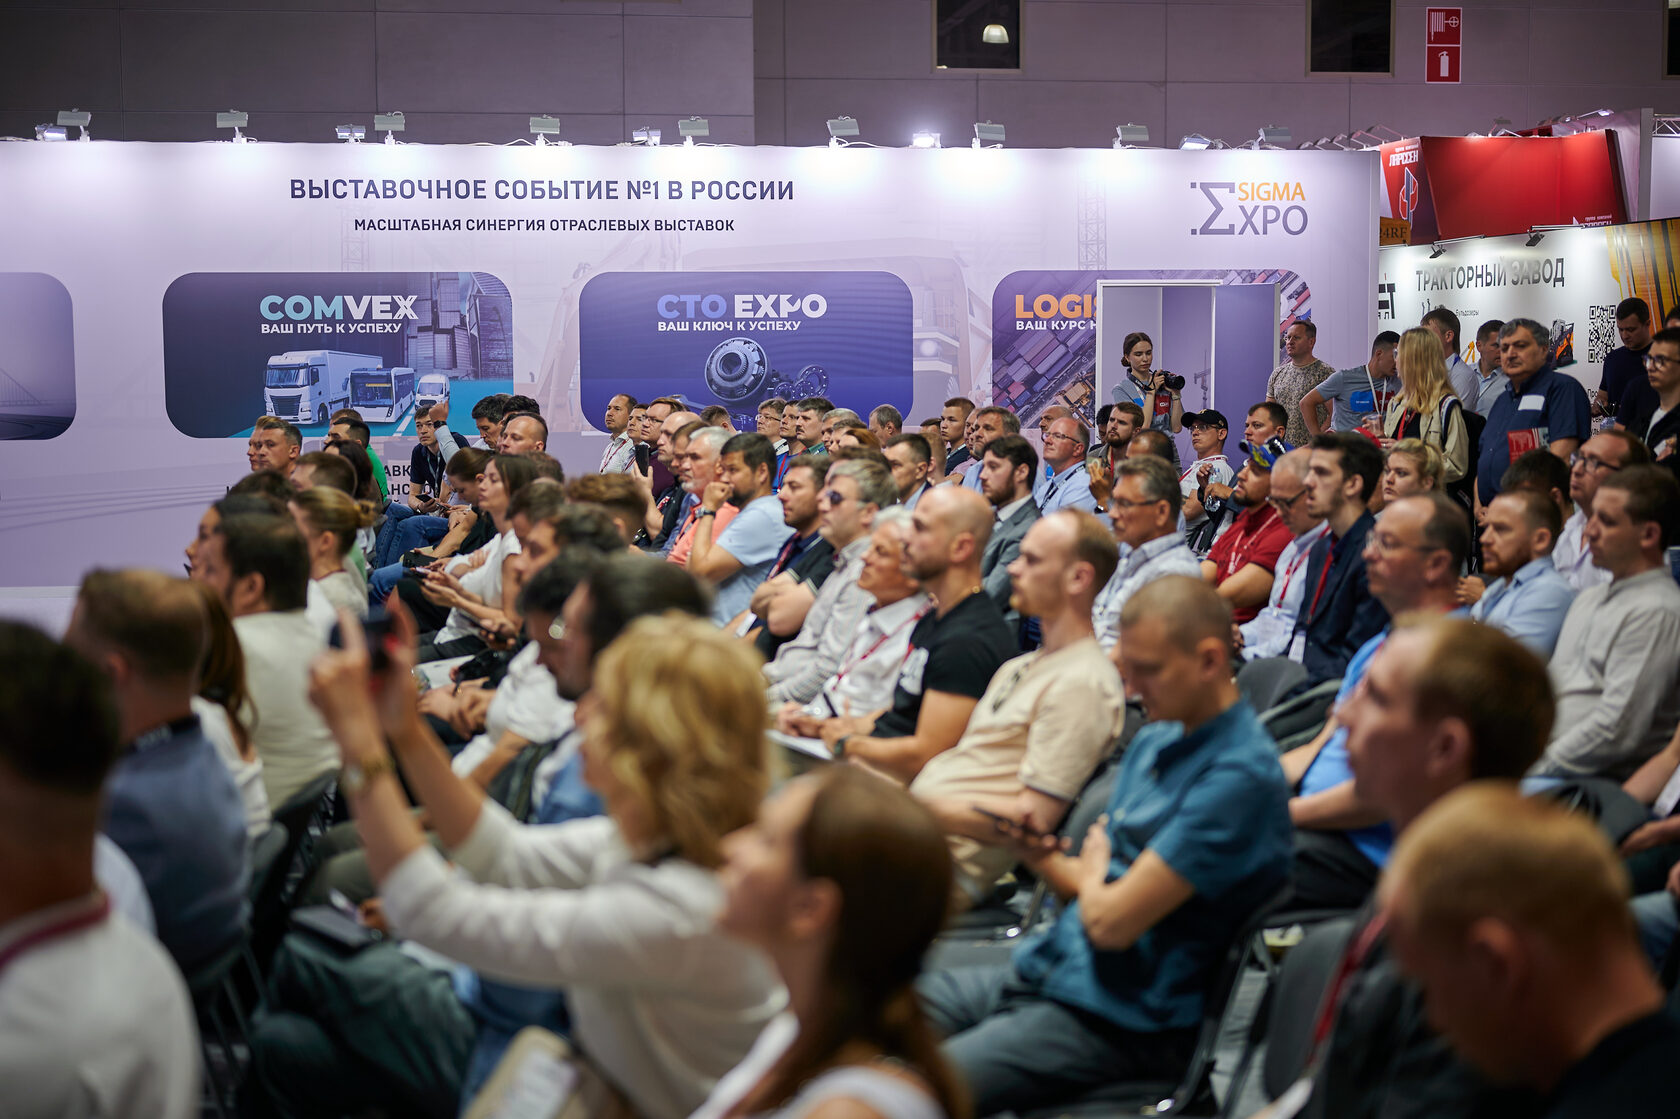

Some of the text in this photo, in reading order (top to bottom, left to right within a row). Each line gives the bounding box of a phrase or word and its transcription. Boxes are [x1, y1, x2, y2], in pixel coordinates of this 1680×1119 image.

[290, 178, 794, 200] ВЫСТАВОЧНОЕ СОБЫТИЕ №1 В РОССИИ
[1238, 182, 1306, 201] SIGMA
[354, 218, 735, 232] МАСШТАБНАЯ СИНЕРГИЯ ОТРАСЛЕВЫХ ВЫСТАВОК
[1416, 257, 1565, 291] ТРАКТОРНЫЙ ЗАВОД
[259, 295, 419, 321] COMVEX
[657, 293, 828, 319] СТО EXPO
[261, 323, 402, 334] ВАШ ПУТЬ К УСПЕХУ
[657, 321, 802, 332] ВАШ КЛЮЧ К УСПЕХУ
[1016, 320, 1047, 330] ВАШ
[1051, 320, 1086, 330] КУРС
